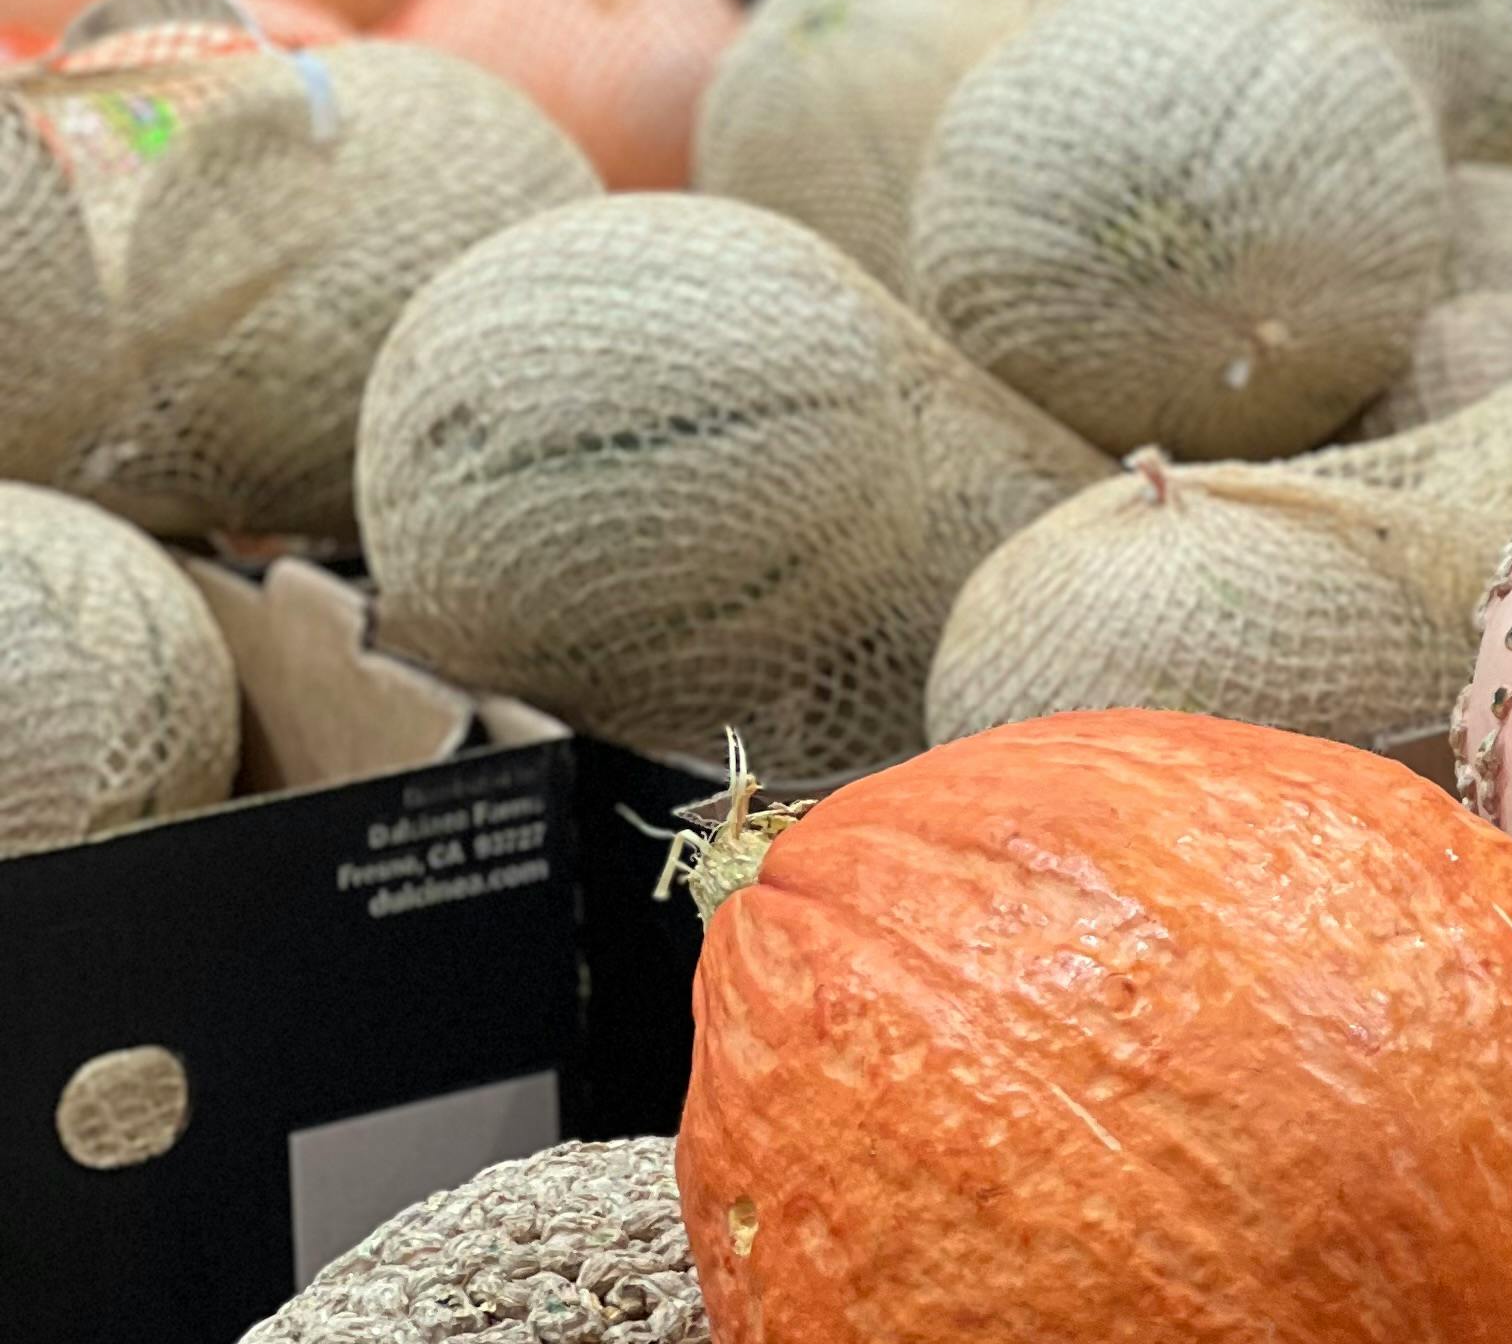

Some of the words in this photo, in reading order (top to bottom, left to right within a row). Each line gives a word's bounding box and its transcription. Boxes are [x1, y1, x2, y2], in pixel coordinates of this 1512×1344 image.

[368, 809, 470, 850] Dulcinea
[427, 840, 466, 869] CA
[368, 859, 549, 918] dulcinea.com
